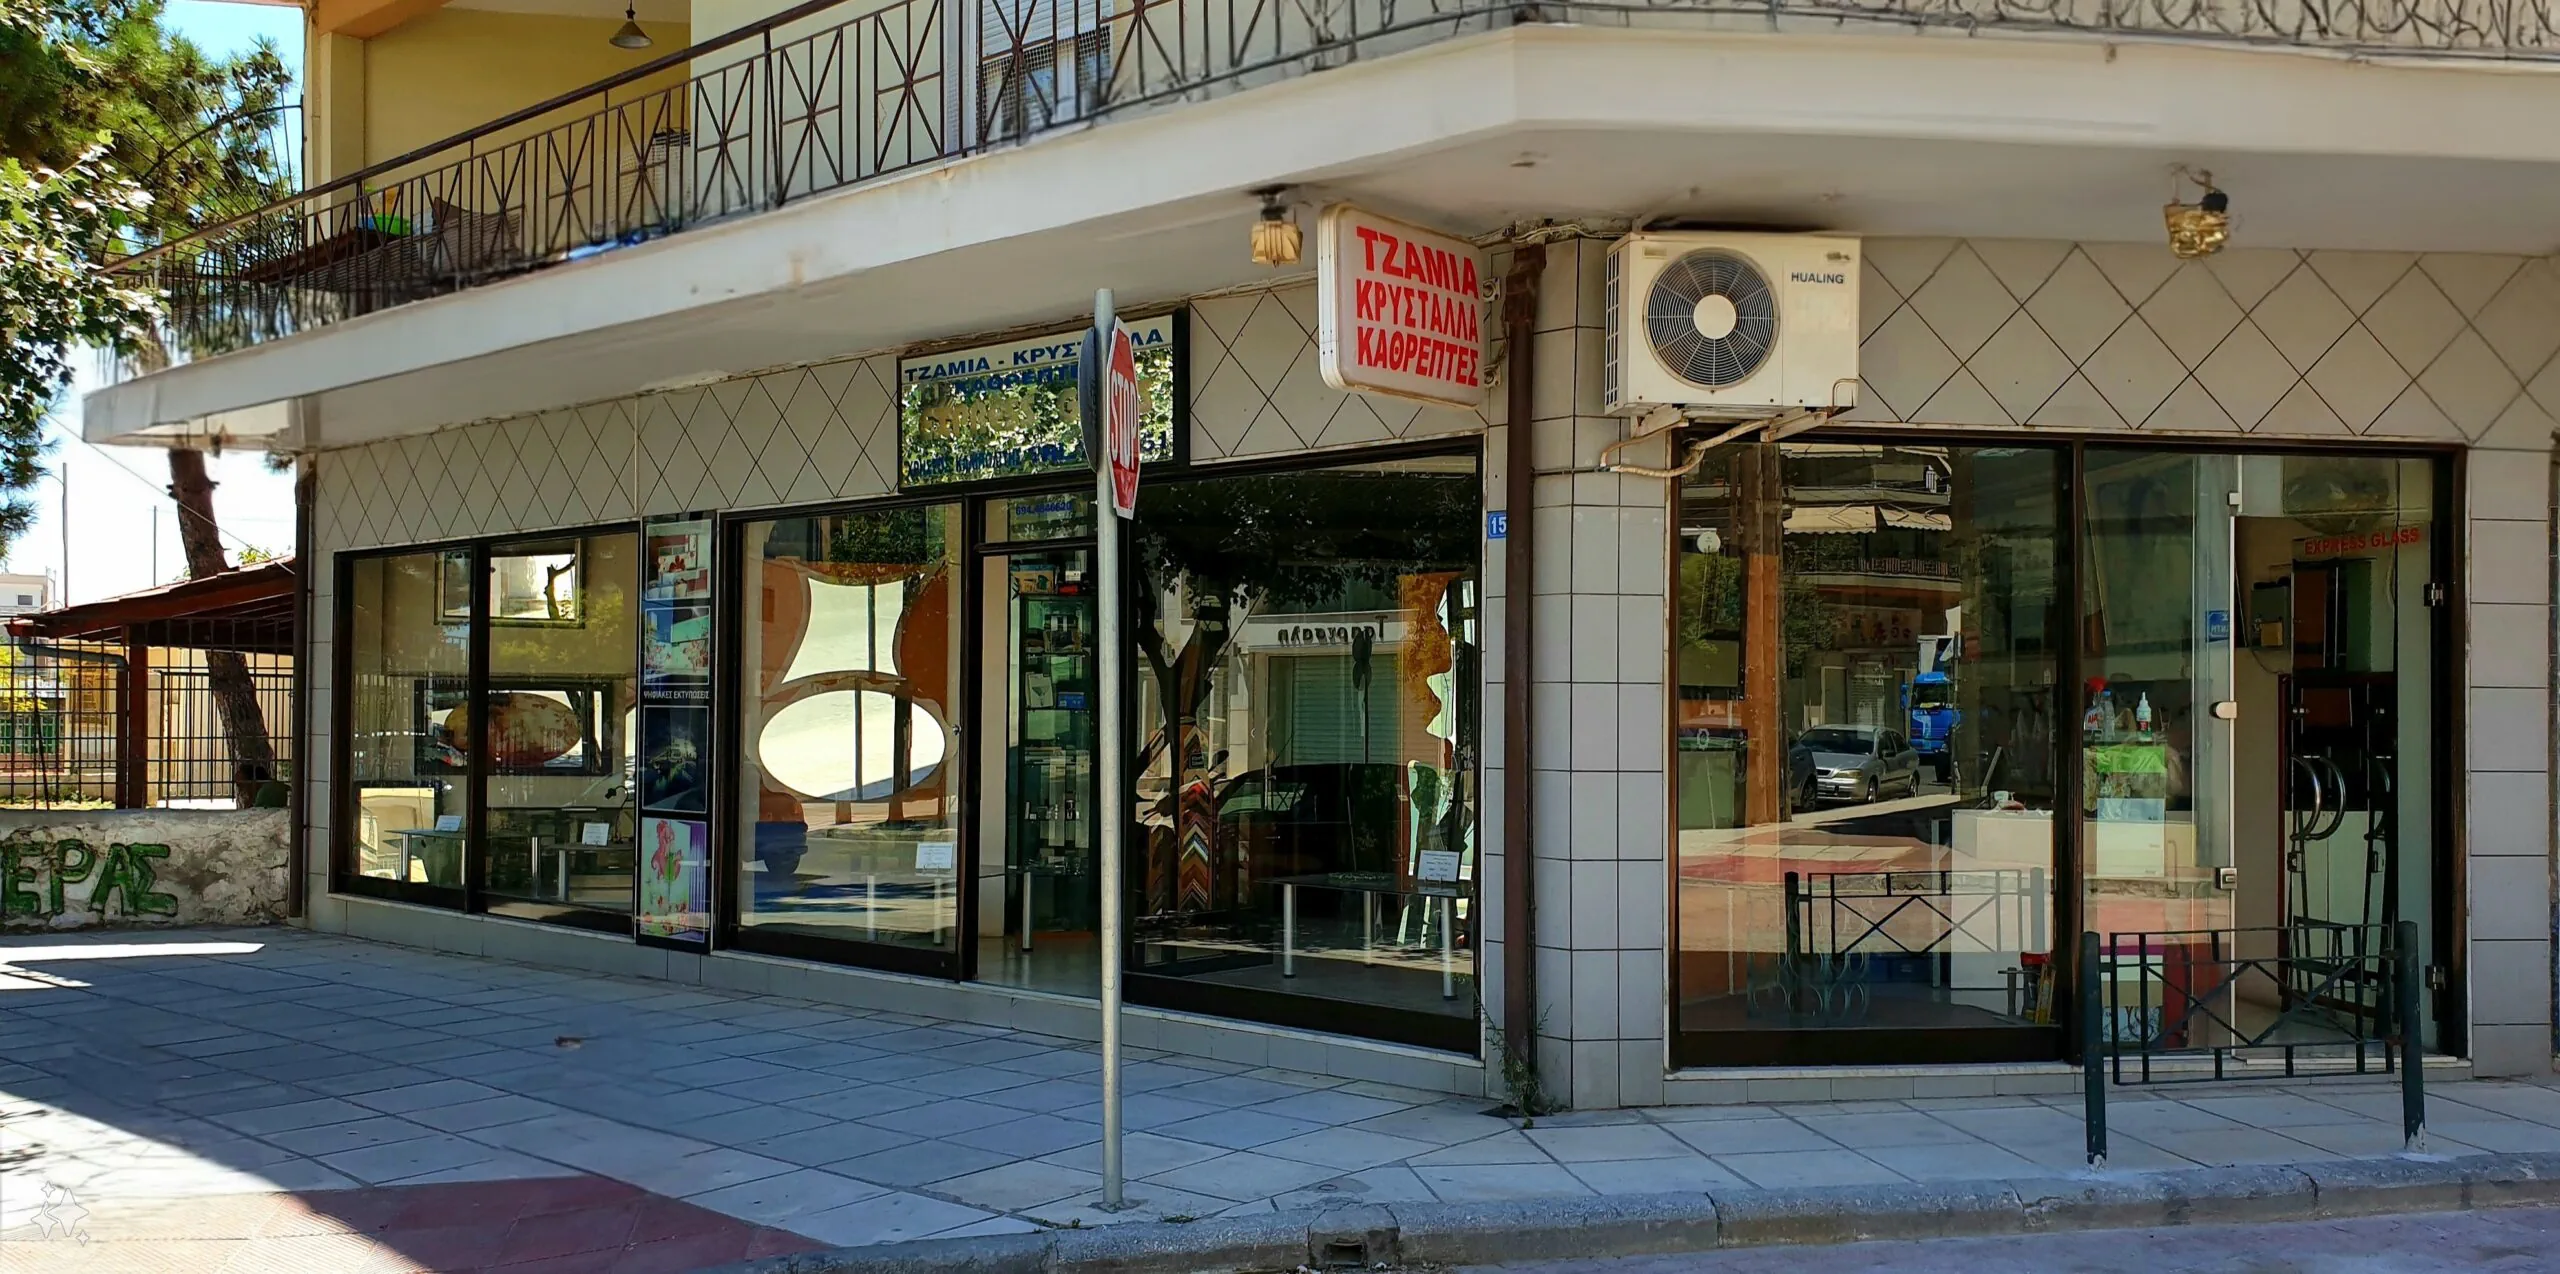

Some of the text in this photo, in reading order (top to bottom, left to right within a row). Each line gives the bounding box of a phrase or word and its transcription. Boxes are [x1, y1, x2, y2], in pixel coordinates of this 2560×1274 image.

[1356, 226, 1479, 300] ΤΖΑΜΙΑ
[1791, 272, 1844, 285] HUALING
[1356, 278, 1479, 343] ΚΡΥΣΤΑΛΛΑ
[904, 356, 990, 382] ΤΖΑΜΙΑ
[1357, 326, 1479, 387] ΚΑΘΡΕΠΤΕΣ
[1111, 369, 1137, 471] STOP
[1491, 516, 1507, 534] 15
[2304, 528, 2419, 555] EXPRESS GLASS
